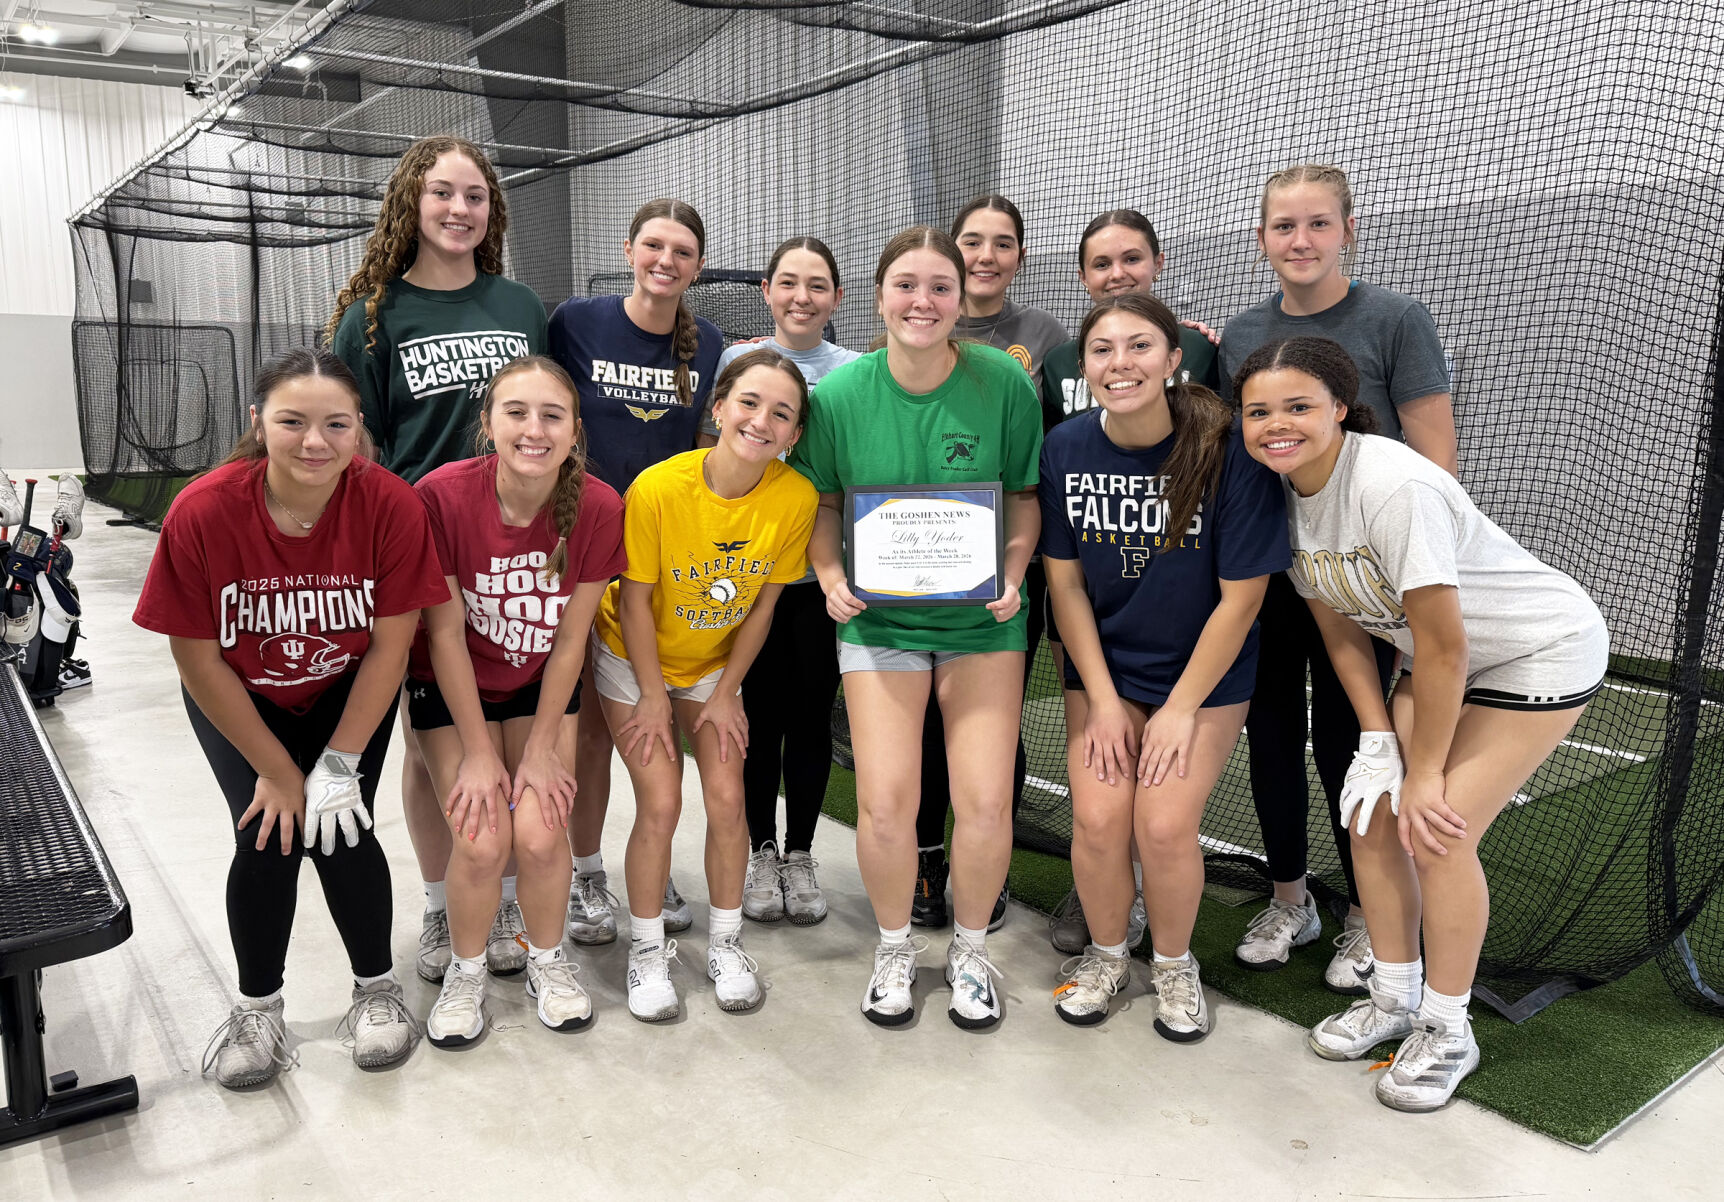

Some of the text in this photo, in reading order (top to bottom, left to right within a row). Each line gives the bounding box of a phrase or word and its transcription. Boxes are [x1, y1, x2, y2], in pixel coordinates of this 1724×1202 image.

[400, 336, 529, 371] HUNTINGTON
[405, 357, 512, 393] BASKETB
[591, 359, 700, 393] FAIRFIED
[603, 386, 684, 405] VOLLEYBA
[1065, 473, 1173, 496] FAIRFIE
[879, 510, 971, 520] THE GOSHEN NEWS
[890, 529, 964, 548] Lilly Yoder
[490, 551, 547, 574] HOO
[241, 574, 360, 591] 2025 NATIONAL
[475, 569, 560, 595] HOO
[462, 586, 571, 627] HOO
